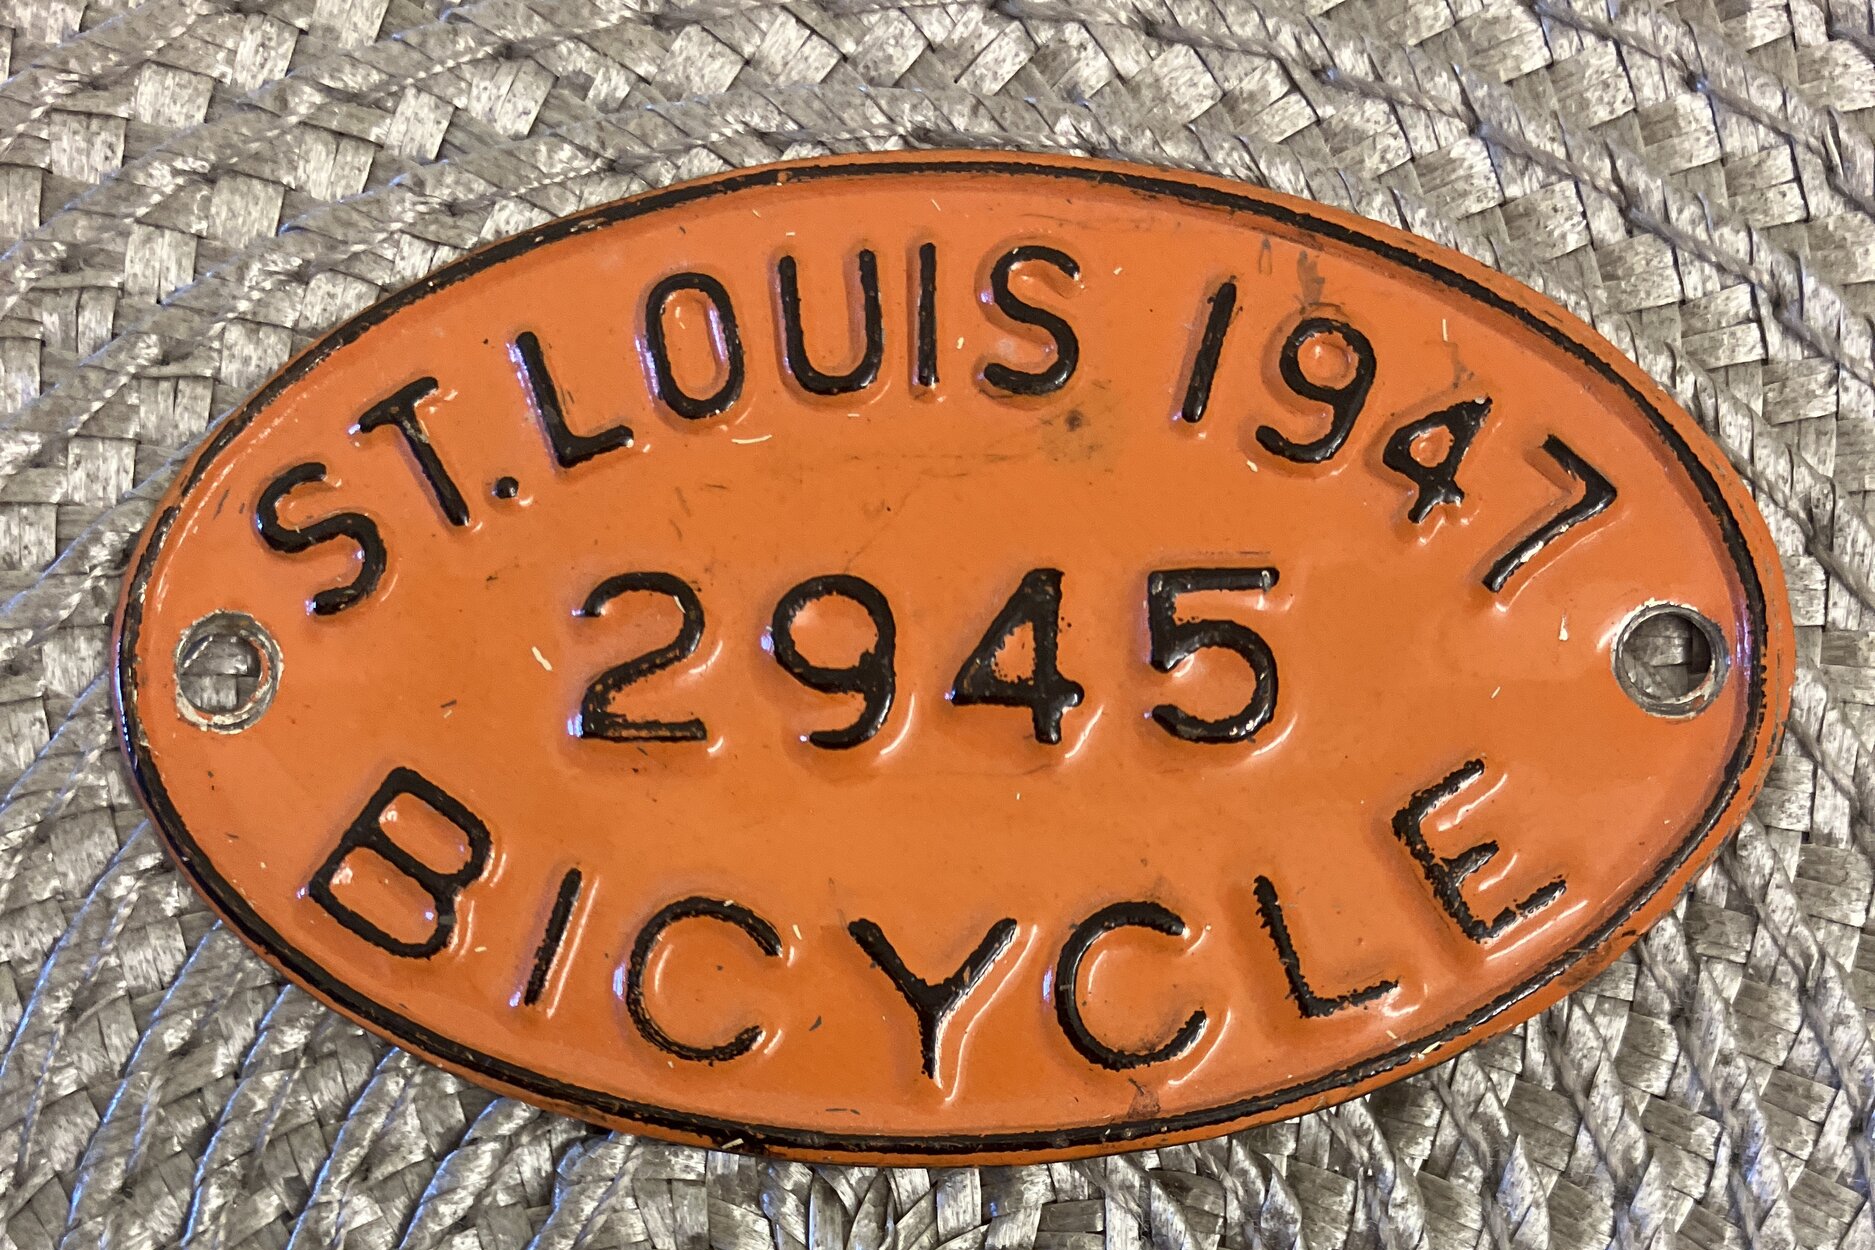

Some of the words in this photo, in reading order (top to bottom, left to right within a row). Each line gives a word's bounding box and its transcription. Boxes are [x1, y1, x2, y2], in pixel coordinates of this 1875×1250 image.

[1180, 280, 1618, 588] 1947
[578, 571, 1279, 746] 2945
[308, 758, 1567, 1080] BICYCLE
